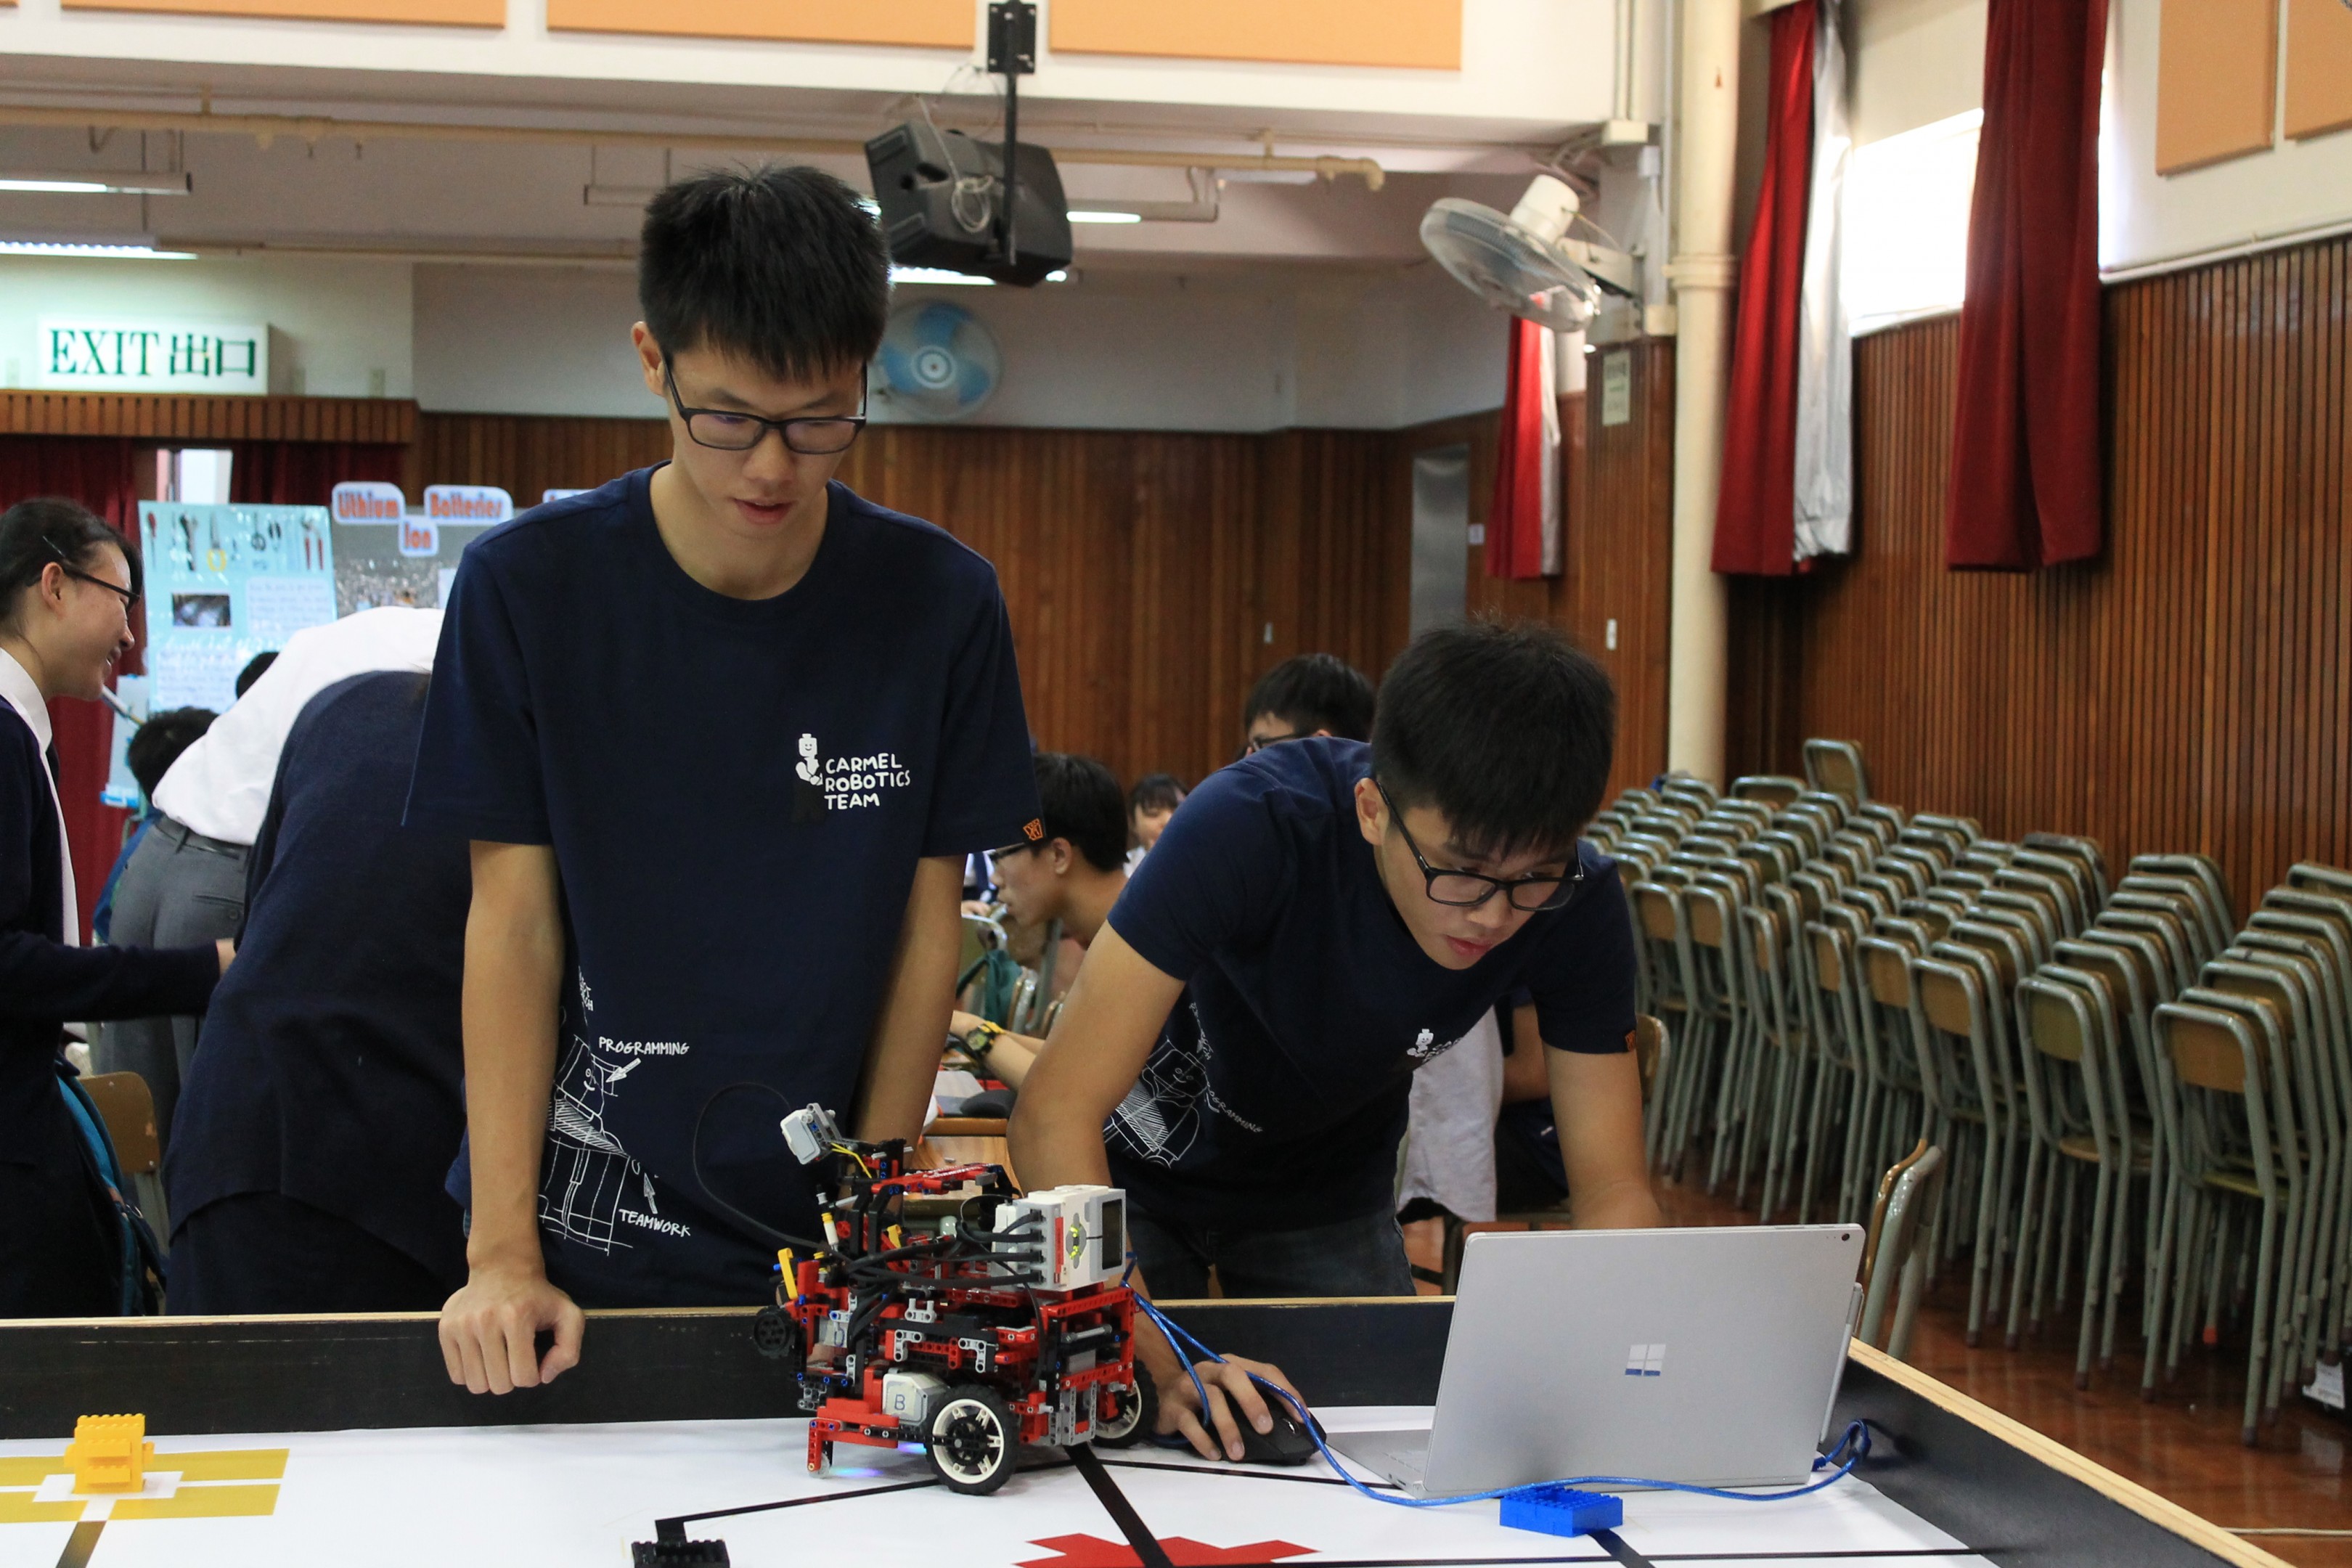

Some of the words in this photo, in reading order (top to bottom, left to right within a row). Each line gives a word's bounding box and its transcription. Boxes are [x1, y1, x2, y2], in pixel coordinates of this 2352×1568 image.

[49, 328, 159, 376] EXIT
[169, 333, 255, 377] 出口
[337, 491, 399, 518] Lithium
[429, 492, 502, 518] Batteries
[404, 523, 432, 549] Ion
[825, 753, 902, 775] CARMEL
[825, 769, 910, 792] ROBOTICS
[824, 793, 880, 809] TEAM
[598, 1036, 690, 1055] PROGRAMMING
[618, 1208, 691, 1238] TEAMWORK
[894, 1394, 905, 1410] B
